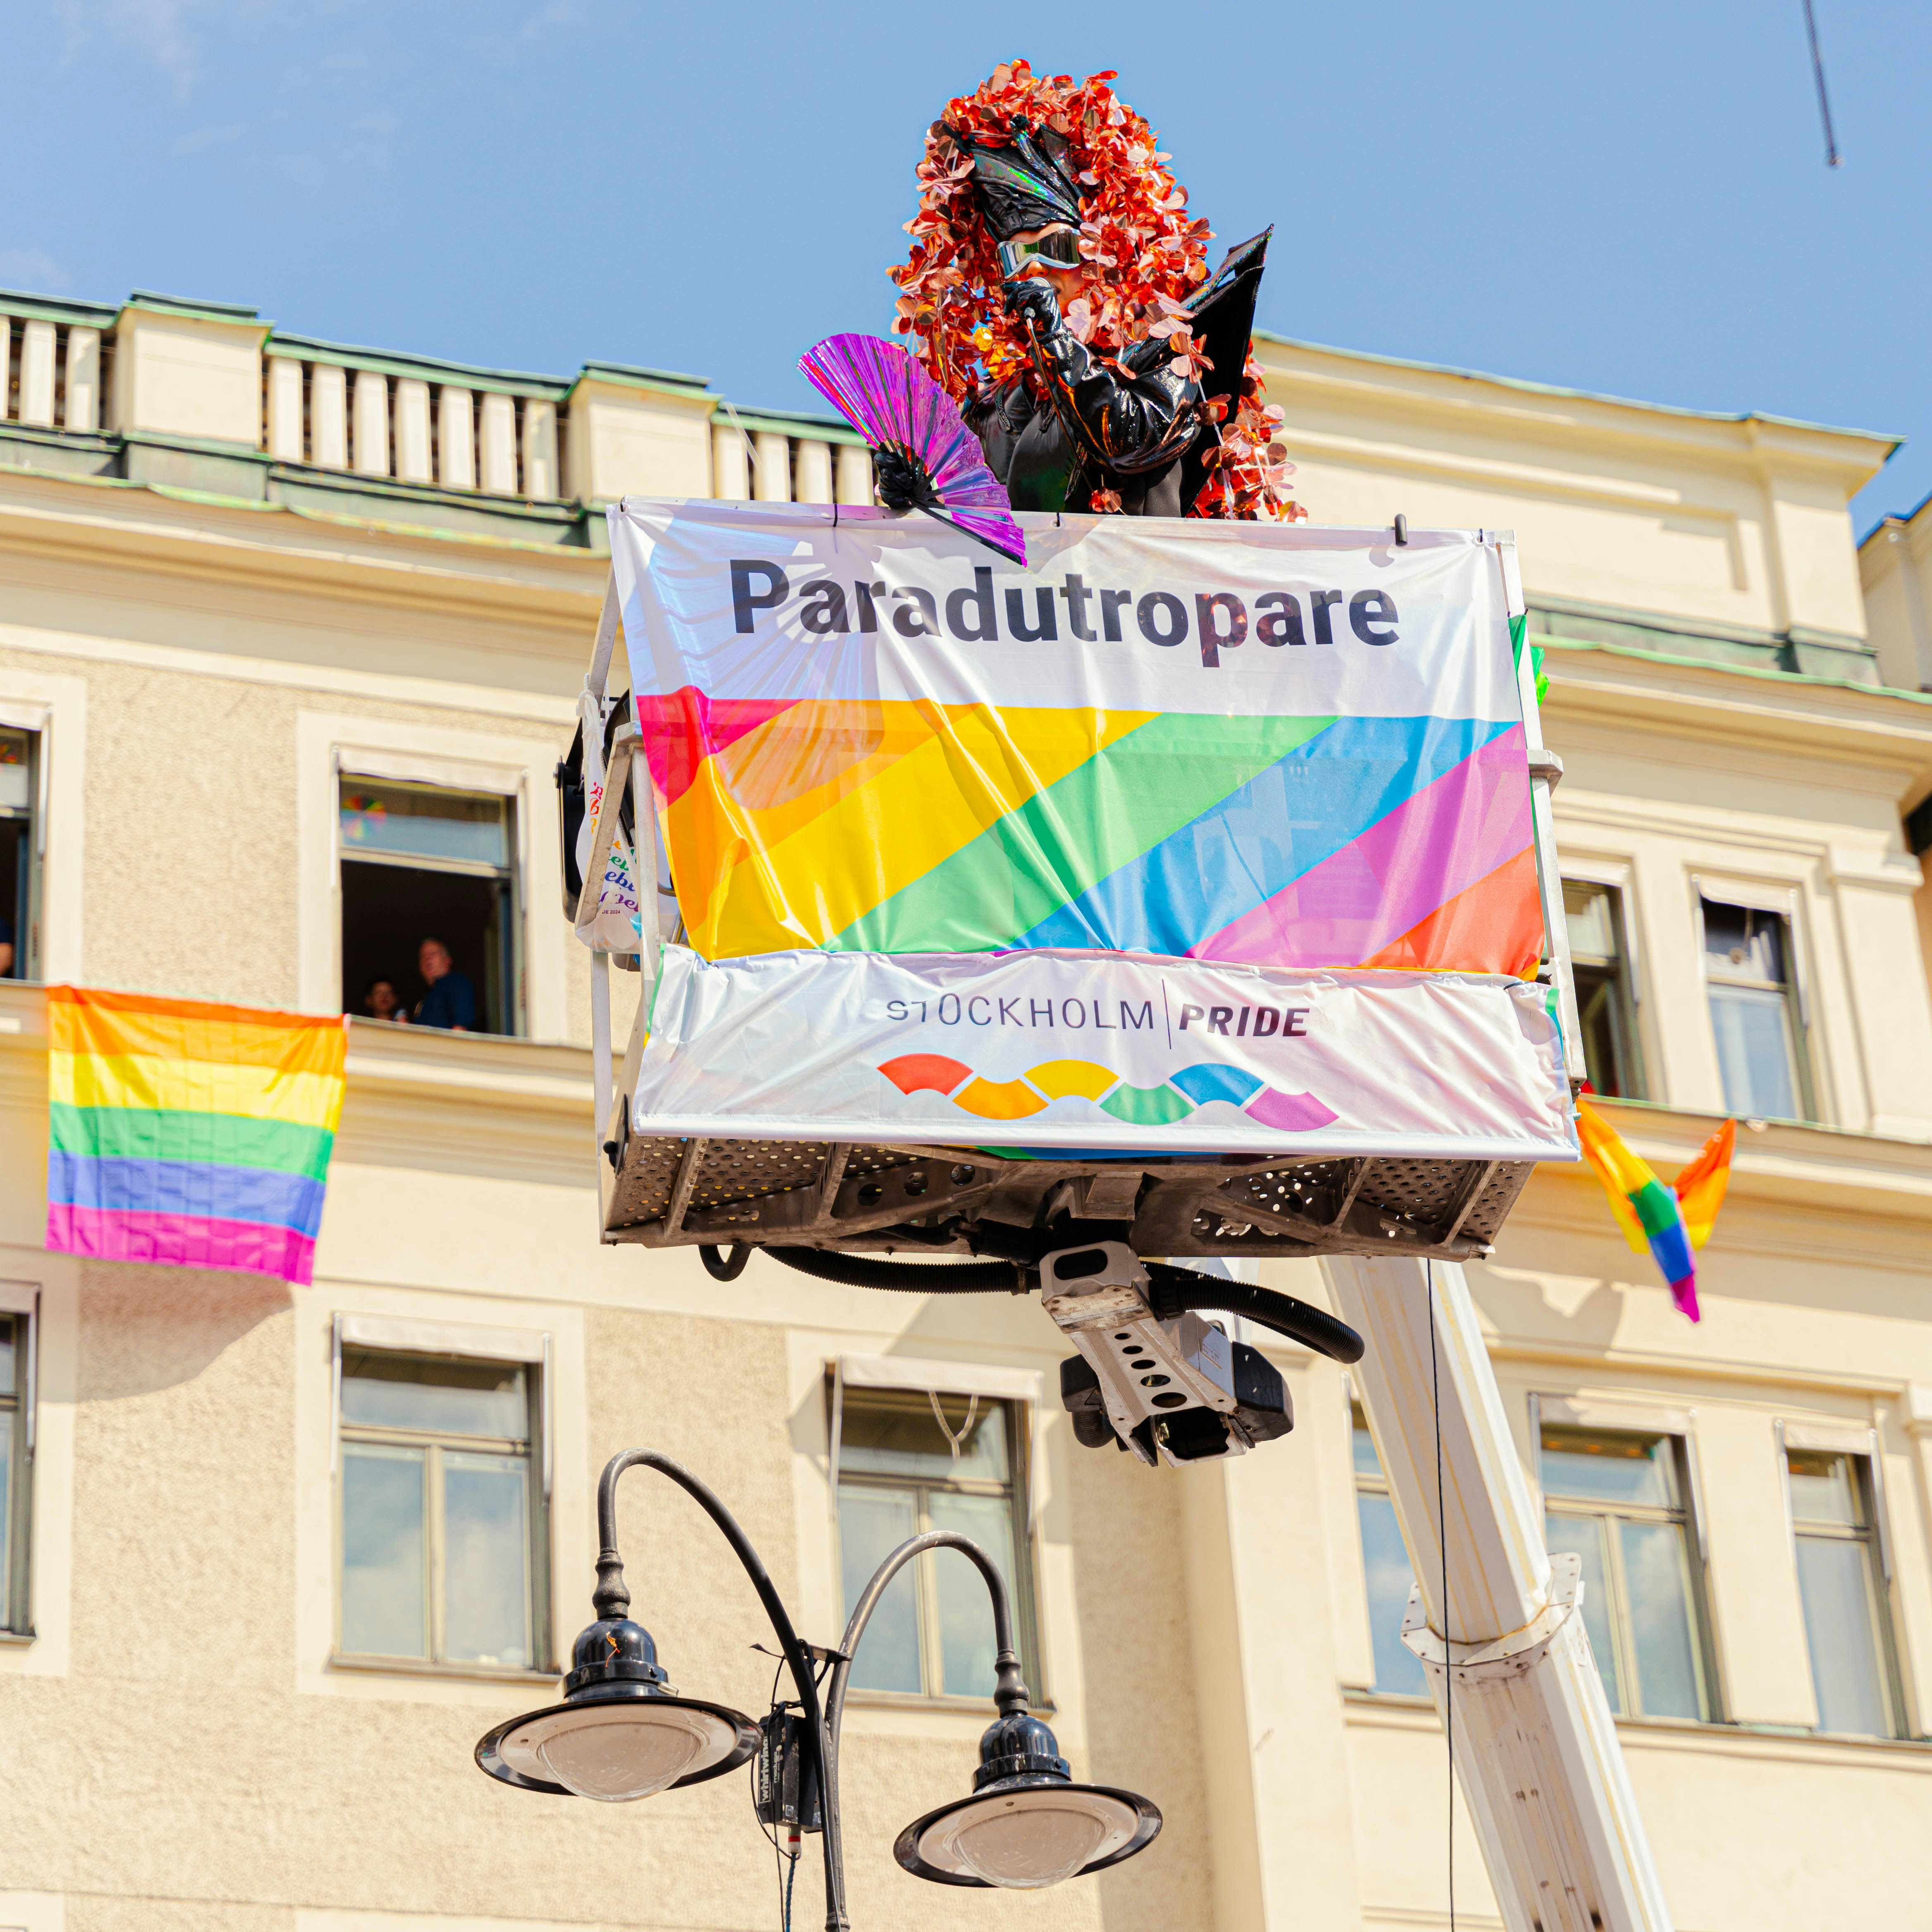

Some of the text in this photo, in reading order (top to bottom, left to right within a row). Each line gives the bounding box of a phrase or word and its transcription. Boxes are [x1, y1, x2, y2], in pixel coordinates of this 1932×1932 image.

[730, 559, 1399, 667] Paradutropare
[887, 993, 1310, 1037] STOCKHOLM PRIDE
